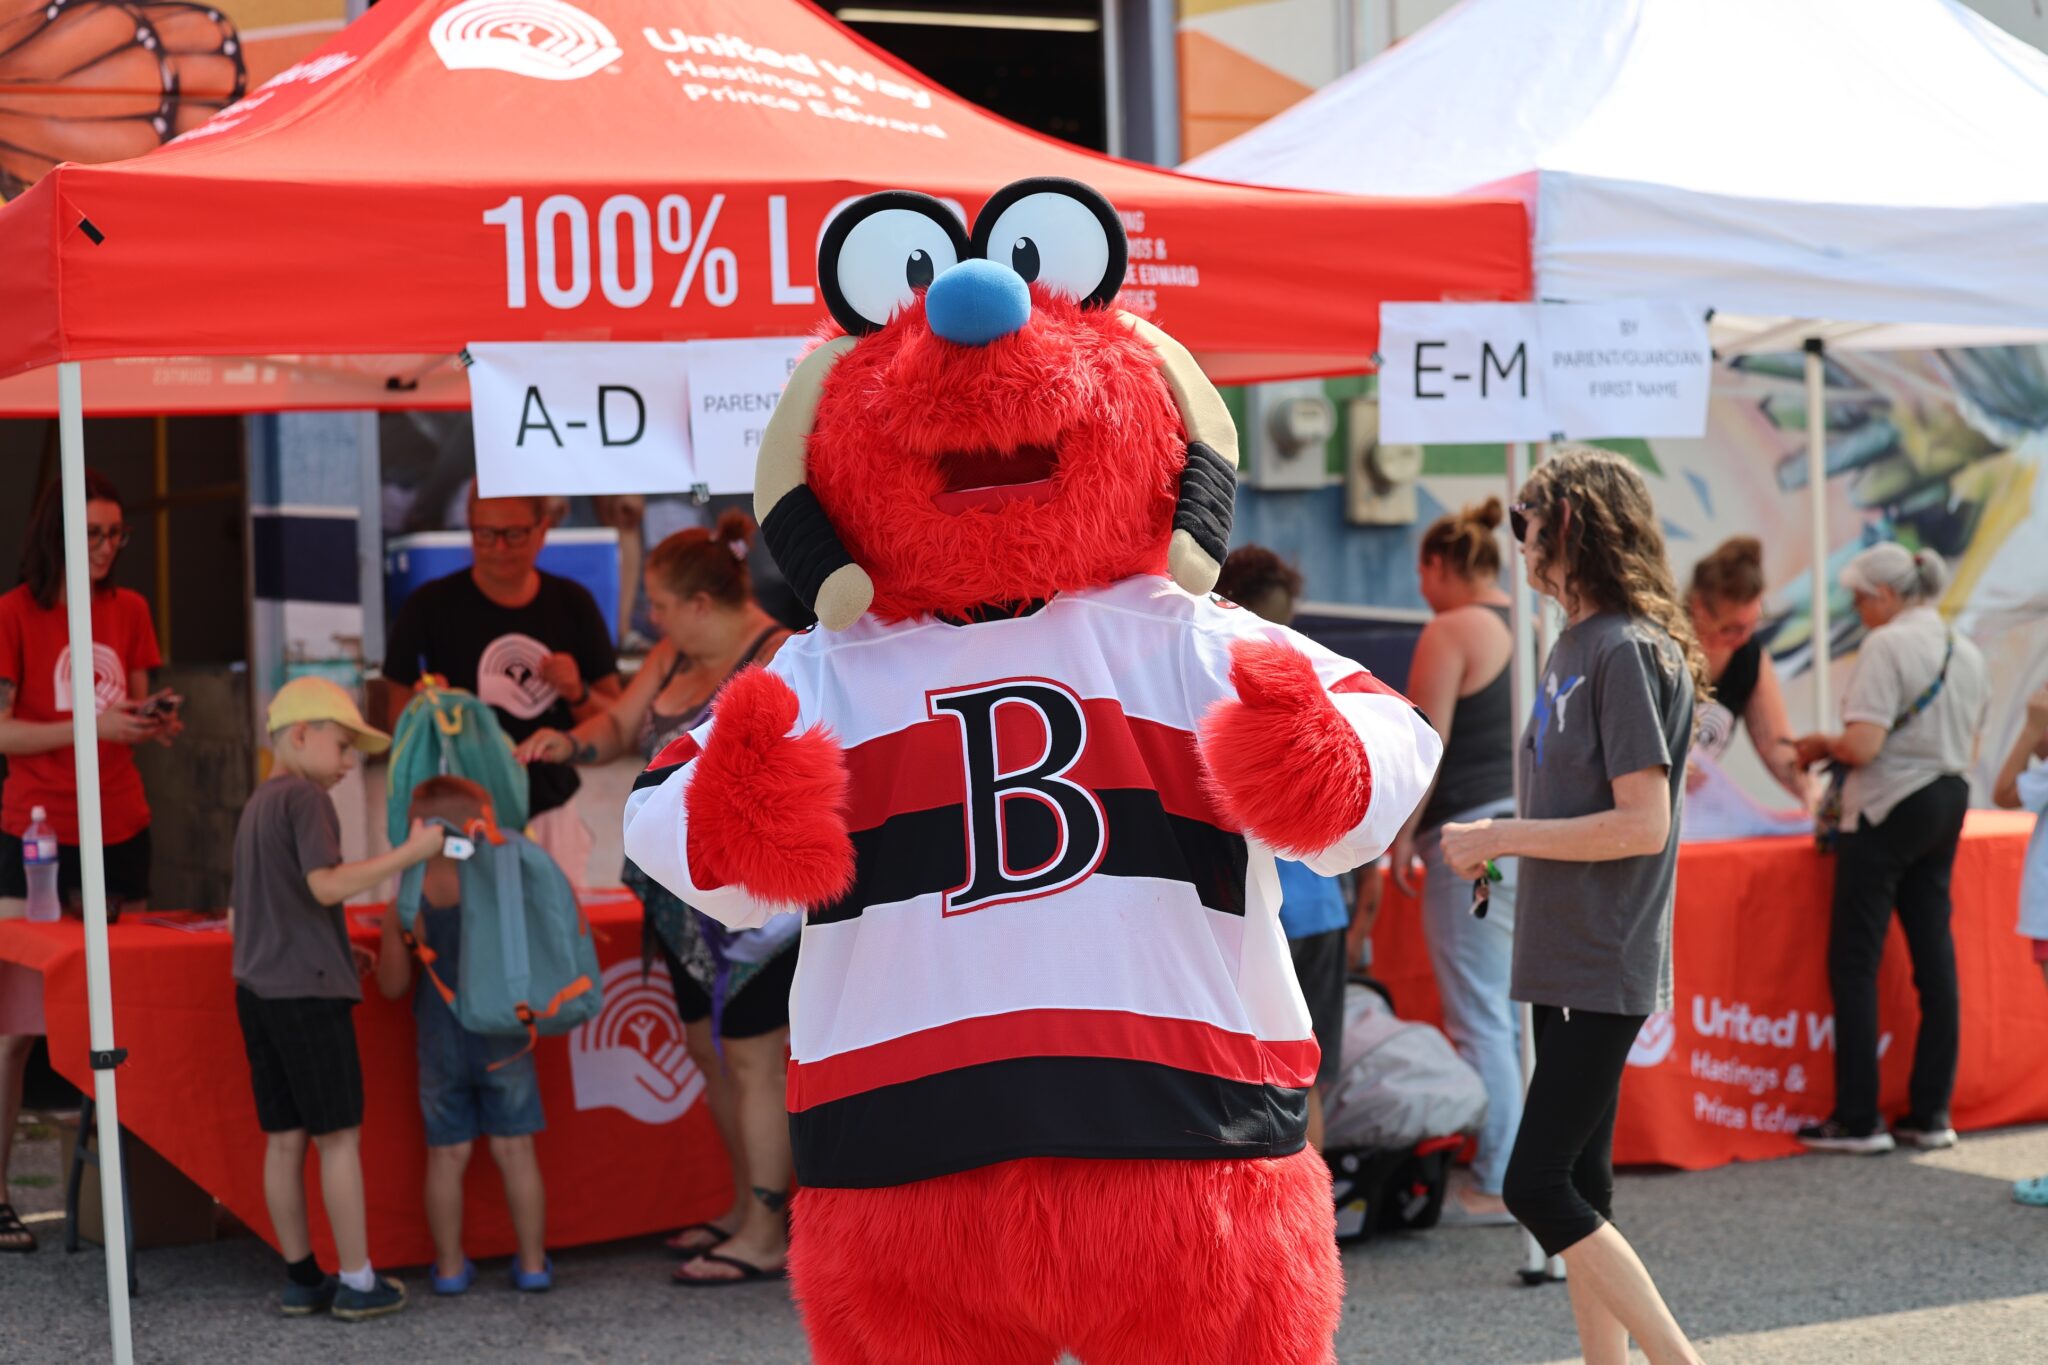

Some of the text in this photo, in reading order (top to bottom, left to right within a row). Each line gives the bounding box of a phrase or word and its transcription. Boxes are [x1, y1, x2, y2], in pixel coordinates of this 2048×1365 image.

[642, 27, 932, 109] United Way
[664, 59, 826, 97] Hastings
[682, 83, 948, 138] Prince Edward
[482, 193, 738, 309] 100%
[1414, 341, 1527, 398] E-M
[515, 385, 646, 447] A-D
[925, 676, 1110, 918] B
[1784, 1062, 1808, 1093] &
